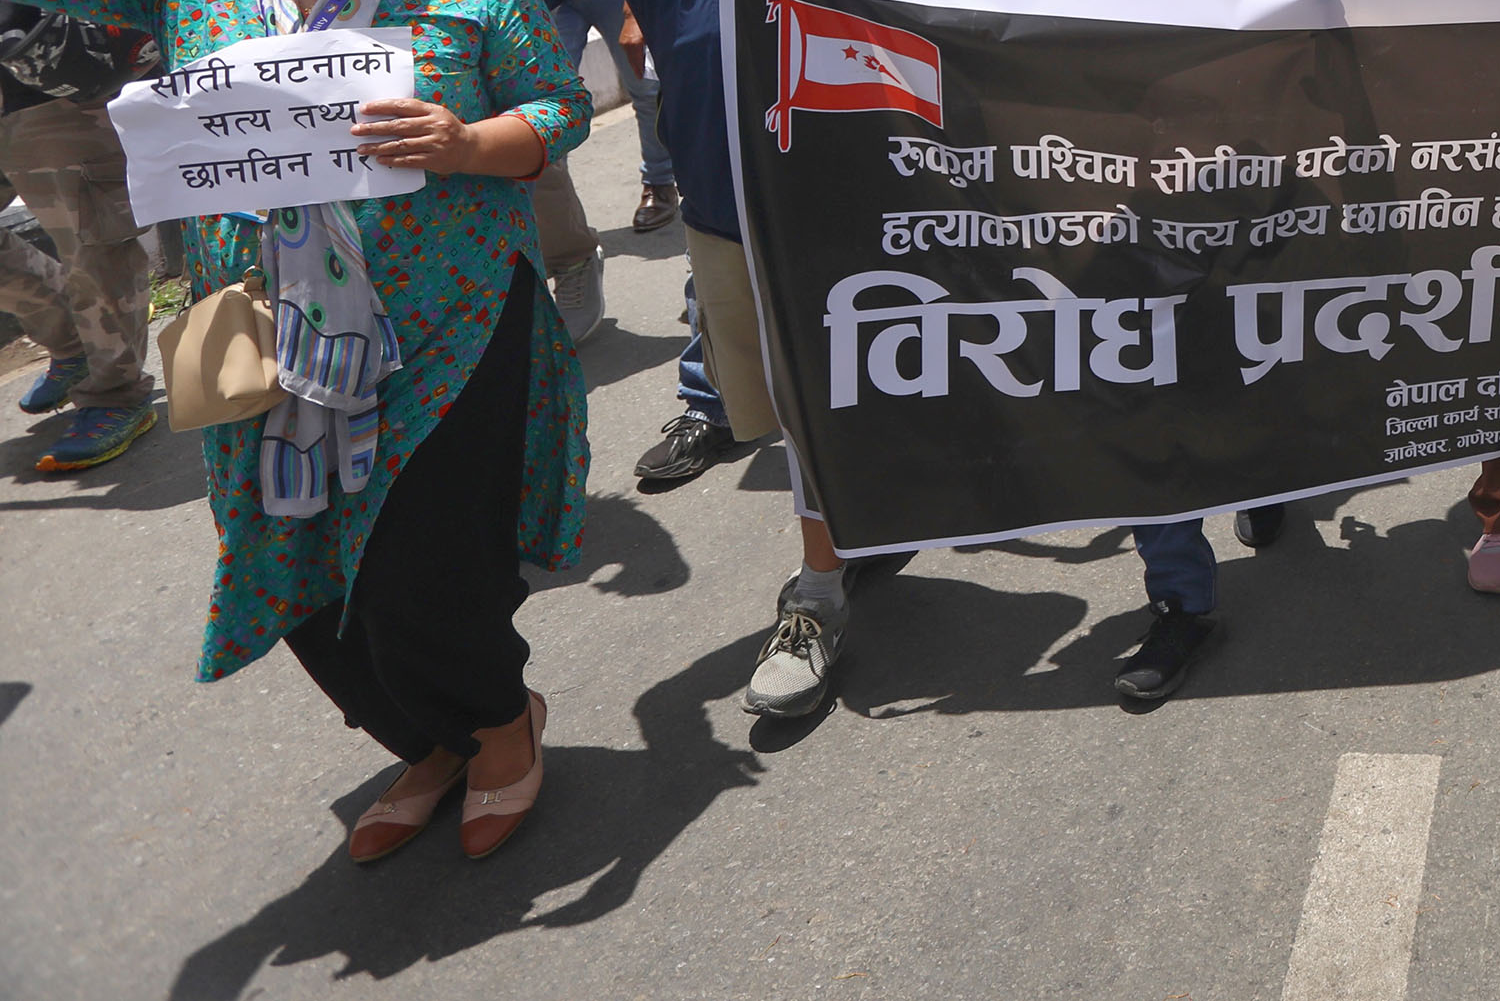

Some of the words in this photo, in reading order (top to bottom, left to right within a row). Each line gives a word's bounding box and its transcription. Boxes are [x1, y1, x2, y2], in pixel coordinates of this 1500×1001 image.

[254, 43, 395, 84] घटनाको
[198, 109, 271, 137] सत्य
[289, 100, 359, 129] तथ्य
[179, 148, 312, 189] छानविन
[888, 135, 997, 188] रुकुम
[1010, 134, 1138, 187] पश्चिम
[1150, 145, 1287, 194] सोतीमा
[1296, 134, 1400, 178] घटेको
[881, 204, 1140, 256] हत्याकाण्डको
[1152, 218, 1239, 254] सत्य
[1249, 204, 1331, 247] तथ्य
[1341, 187, 1484, 235] छानविन
[823, 268, 1187, 410] विरोध
[1386, 379, 1468, 408] नेपाल
[1385, 414, 1439, 436] जिल्ला
[1443, 405, 1479, 425] कार्य
